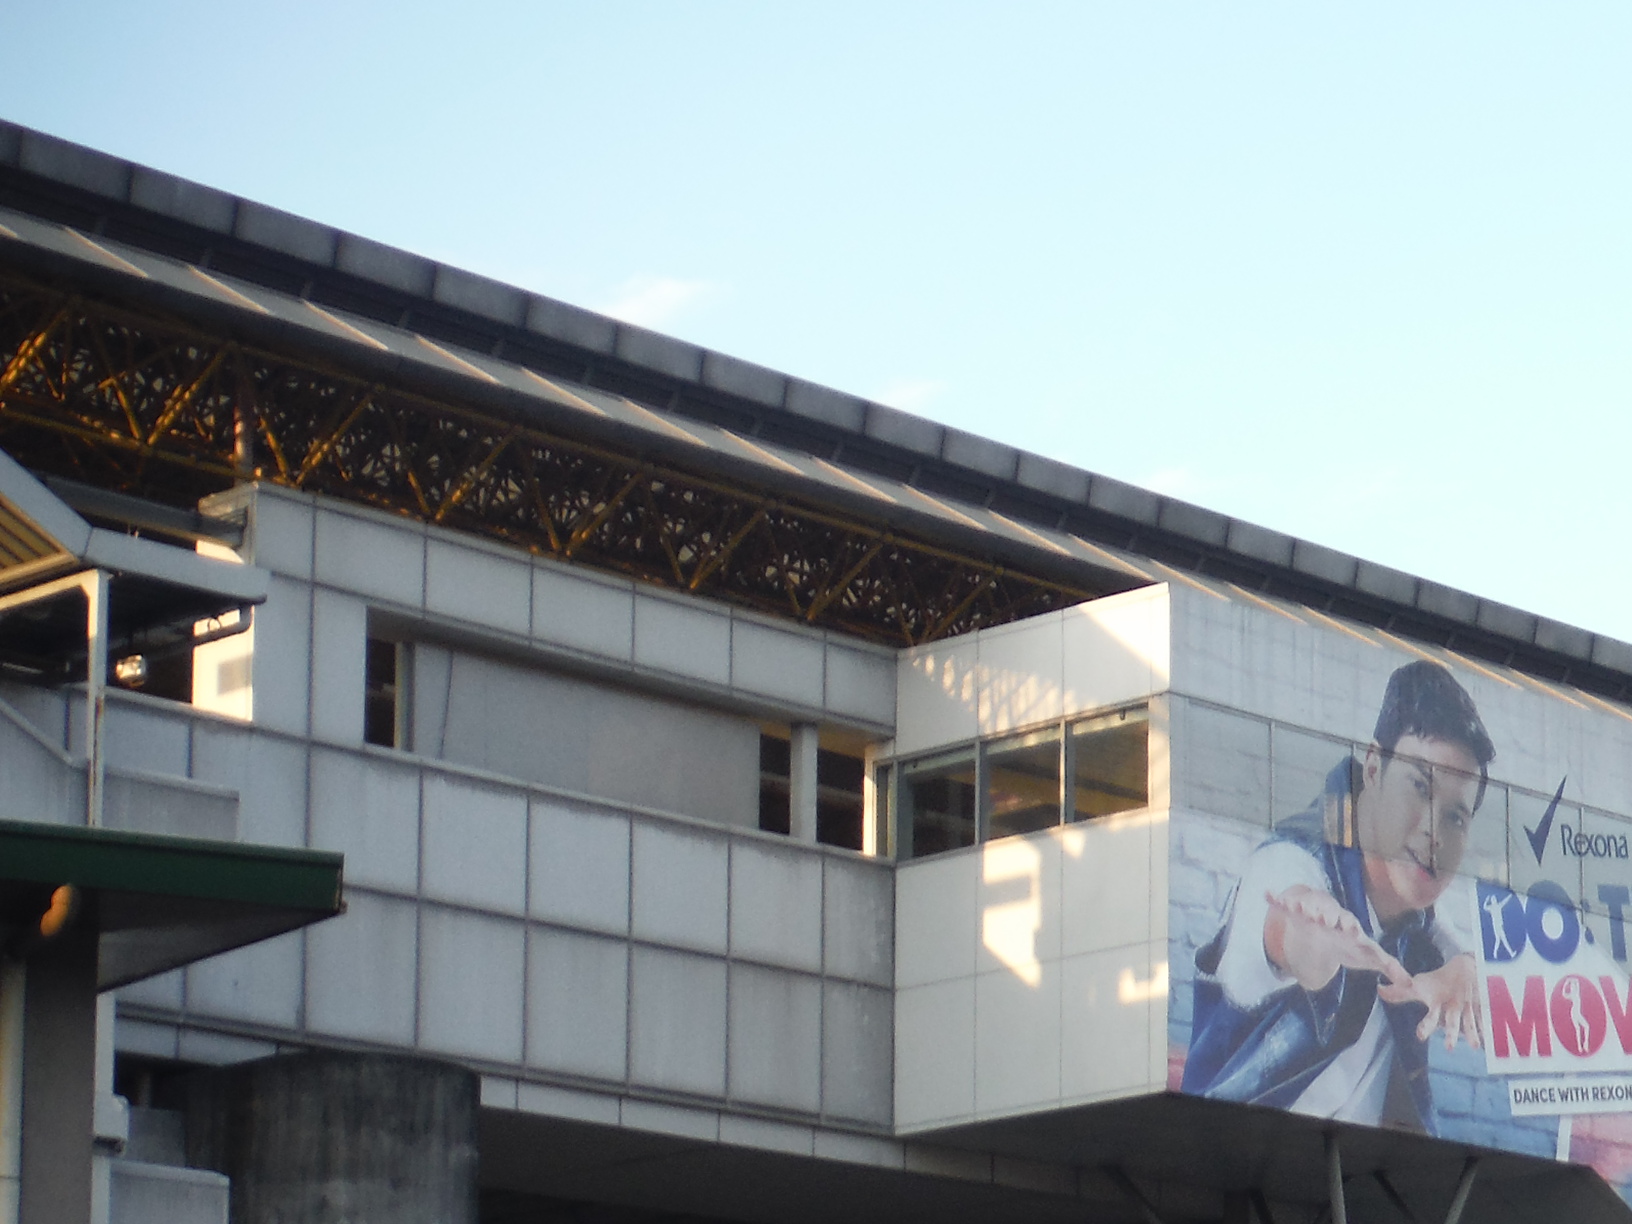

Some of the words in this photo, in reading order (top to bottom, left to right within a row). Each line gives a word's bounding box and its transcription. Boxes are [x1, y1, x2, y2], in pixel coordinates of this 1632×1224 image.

[1560, 824, 1629, 859] Rexona
[1513, 1088, 1556, 1104] DANCE
[1557, 1087, 1590, 1102] WITH
